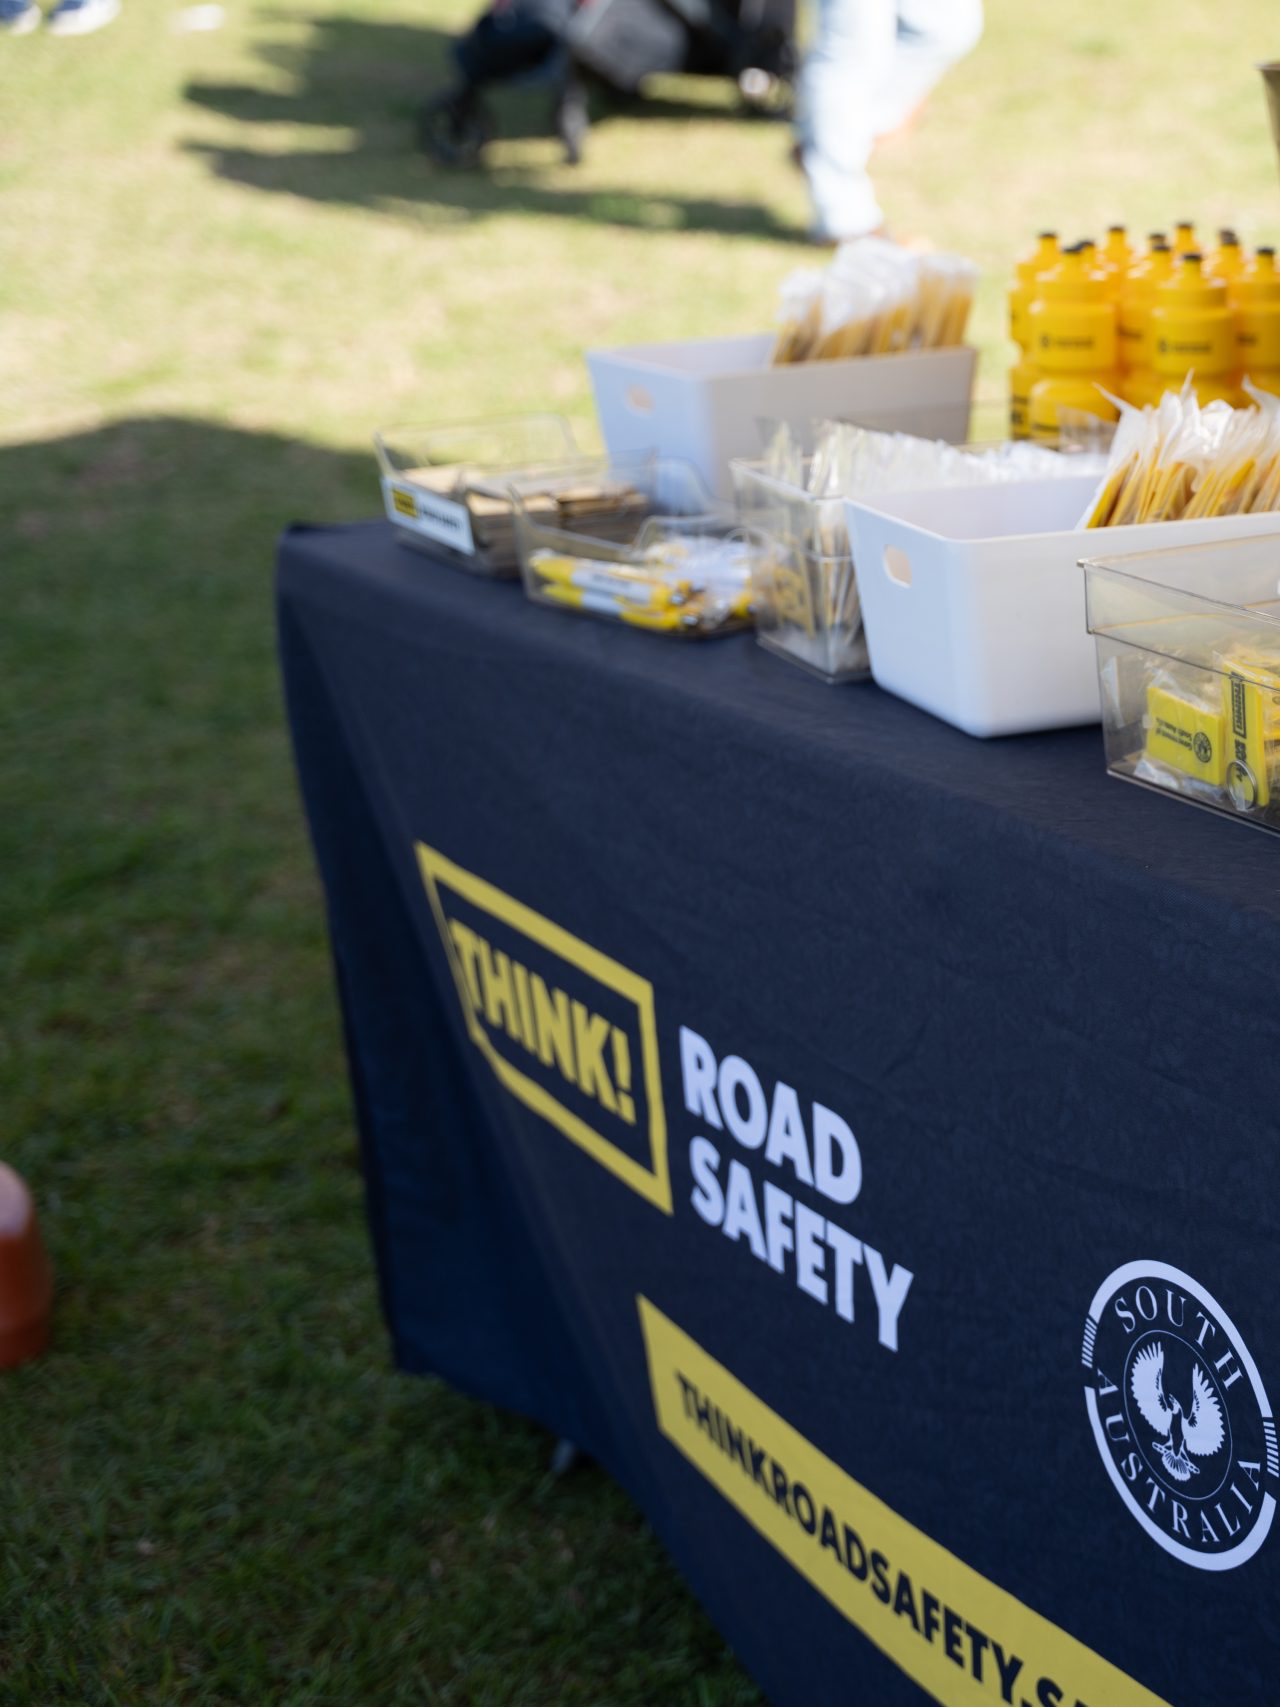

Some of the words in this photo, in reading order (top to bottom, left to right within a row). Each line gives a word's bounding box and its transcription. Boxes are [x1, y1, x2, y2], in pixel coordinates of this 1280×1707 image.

[449, 918, 636, 1126] THINK!
[679, 1025, 862, 1206] ROAD
[690, 1136, 914, 1352] SAFETY
[1114, 1285, 1243, 1391] SOUTH
[675, 1368, 1089, 1707] THINKROADSAFETY.S
[1097, 1369, 1261, 1543] AUSTRALIA
